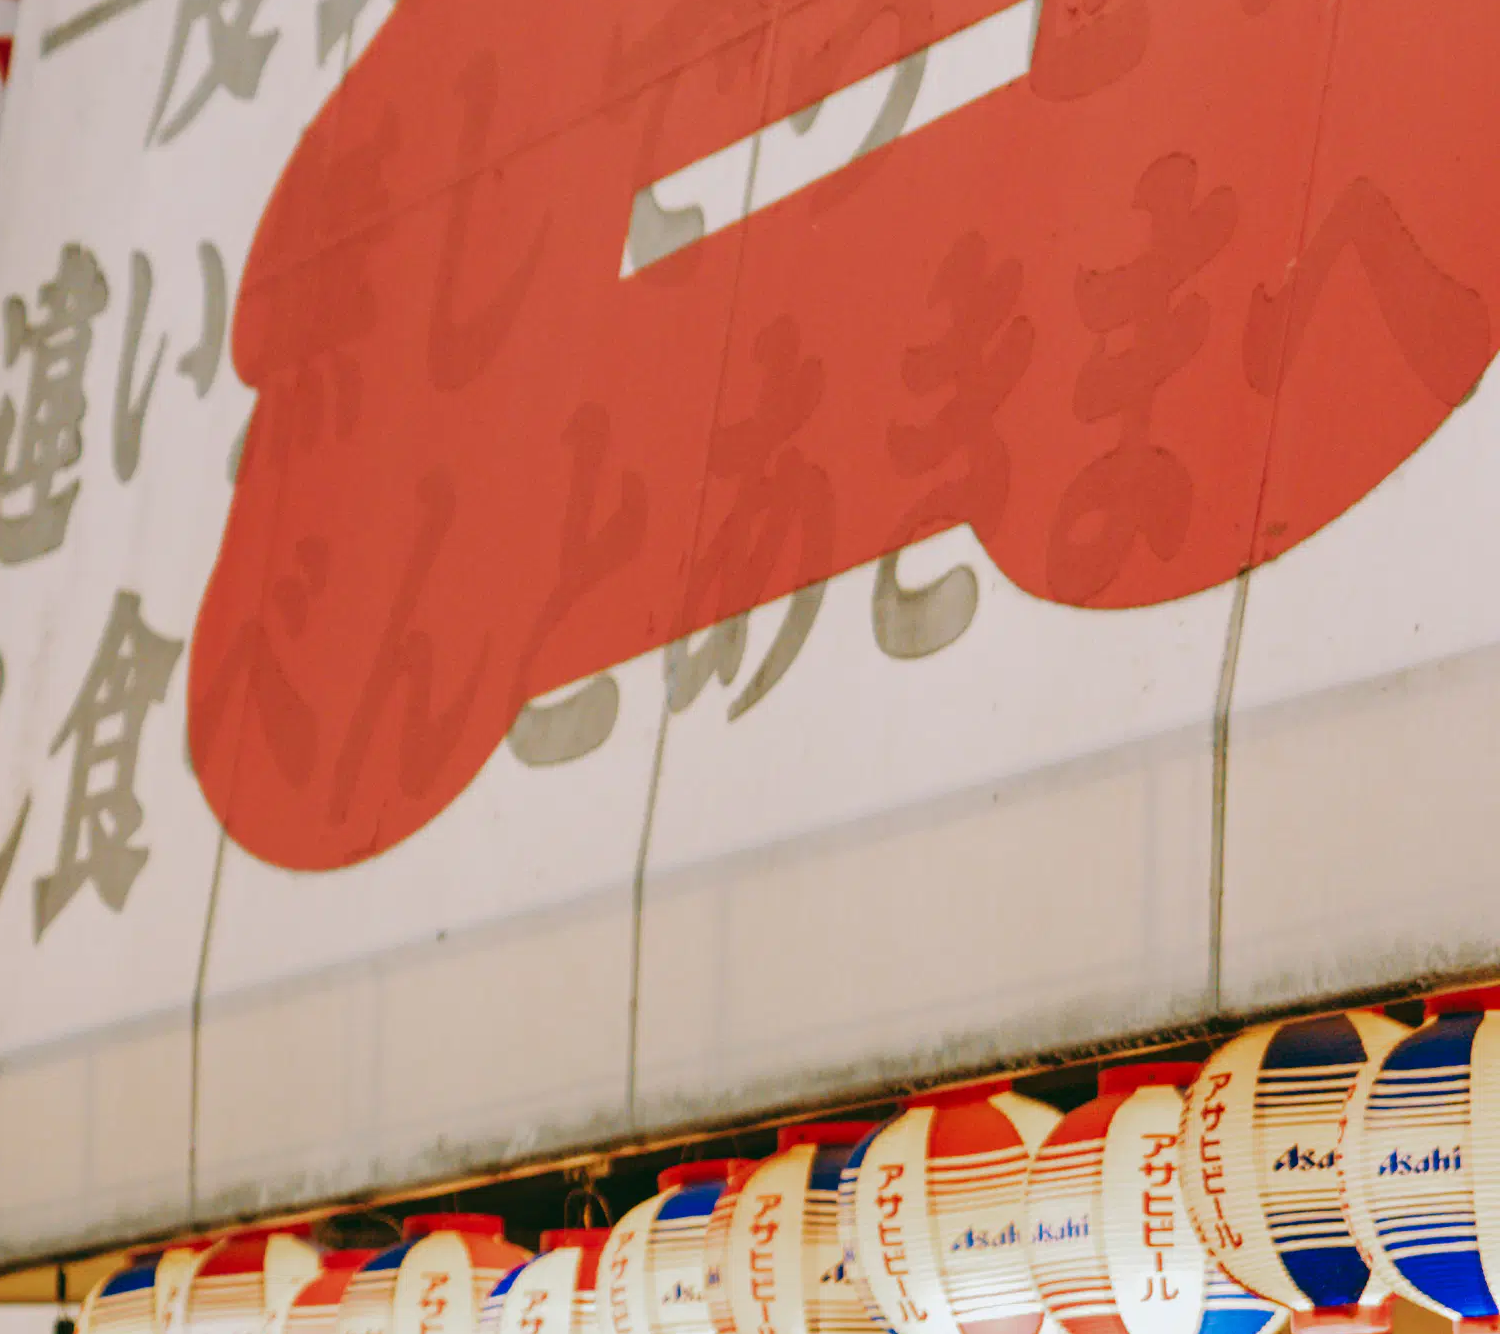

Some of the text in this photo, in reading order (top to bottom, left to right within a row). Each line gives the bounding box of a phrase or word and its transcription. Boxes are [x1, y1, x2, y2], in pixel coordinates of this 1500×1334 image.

[1198, 1070, 1243, 1251] アサヒビール
[1271, 1145, 1337, 1175] Asa
[1377, 1144, 1463, 1178] Asahi
[875, 1162, 929, 1324] アサヒビール
[950, 1221, 1022, 1252] Asah
[1139, 1132, 1181, 1304] アサヒビール
